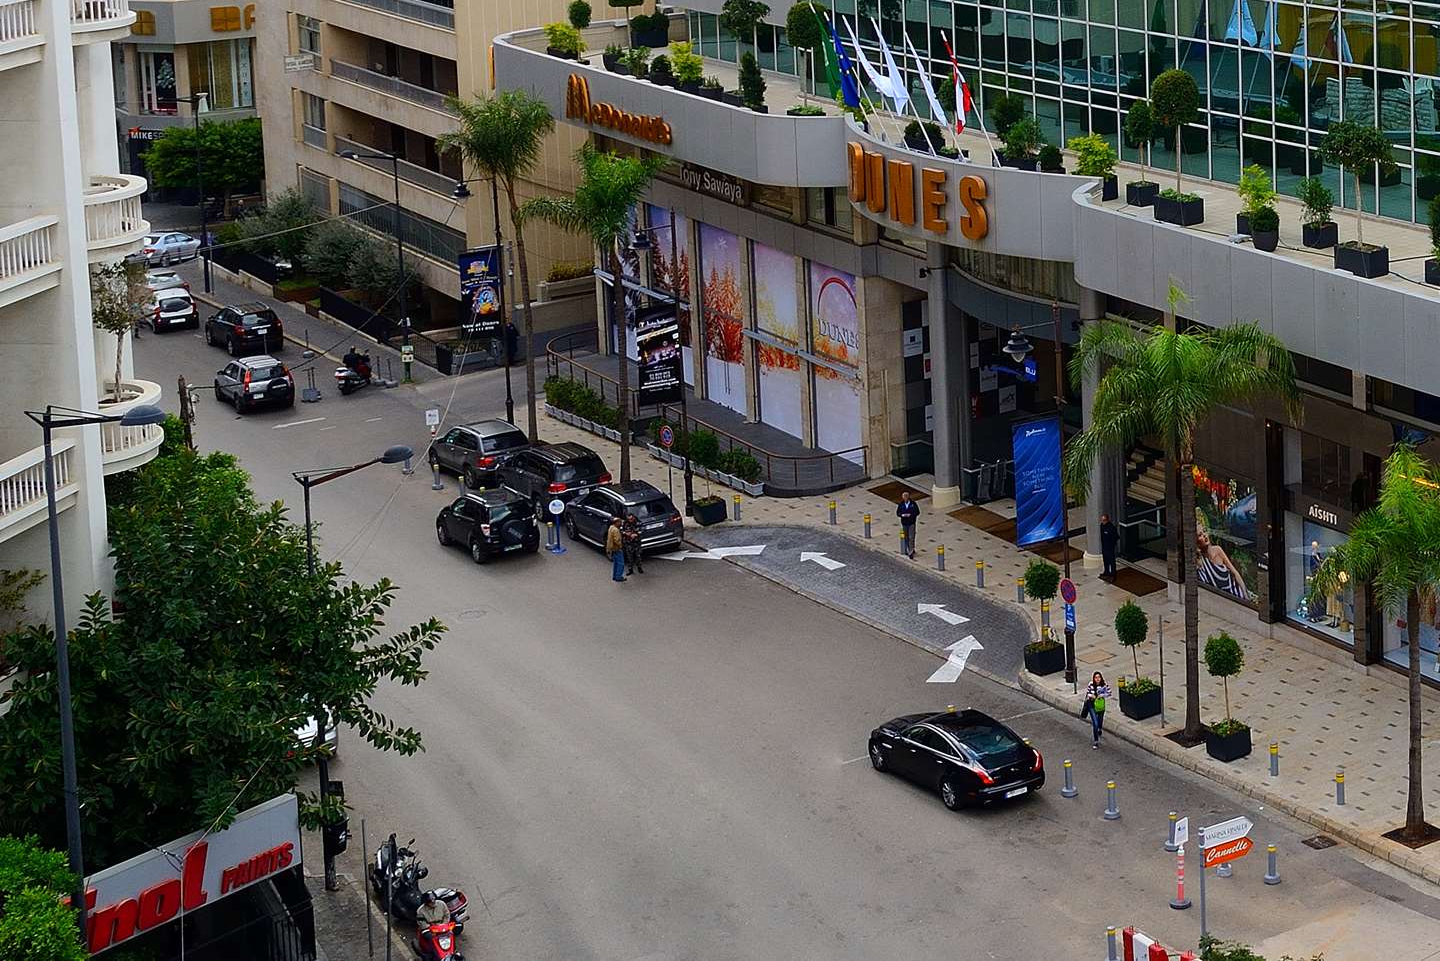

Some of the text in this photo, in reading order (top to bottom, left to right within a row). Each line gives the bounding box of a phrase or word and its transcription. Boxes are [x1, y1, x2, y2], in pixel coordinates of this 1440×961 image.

[703, 171, 742, 203] Sawaya
[847, 141, 990, 240] DUNES
[1206, 840, 1249, 863] Cannelle
[62, 840, 295, 955] inol PAINTS
